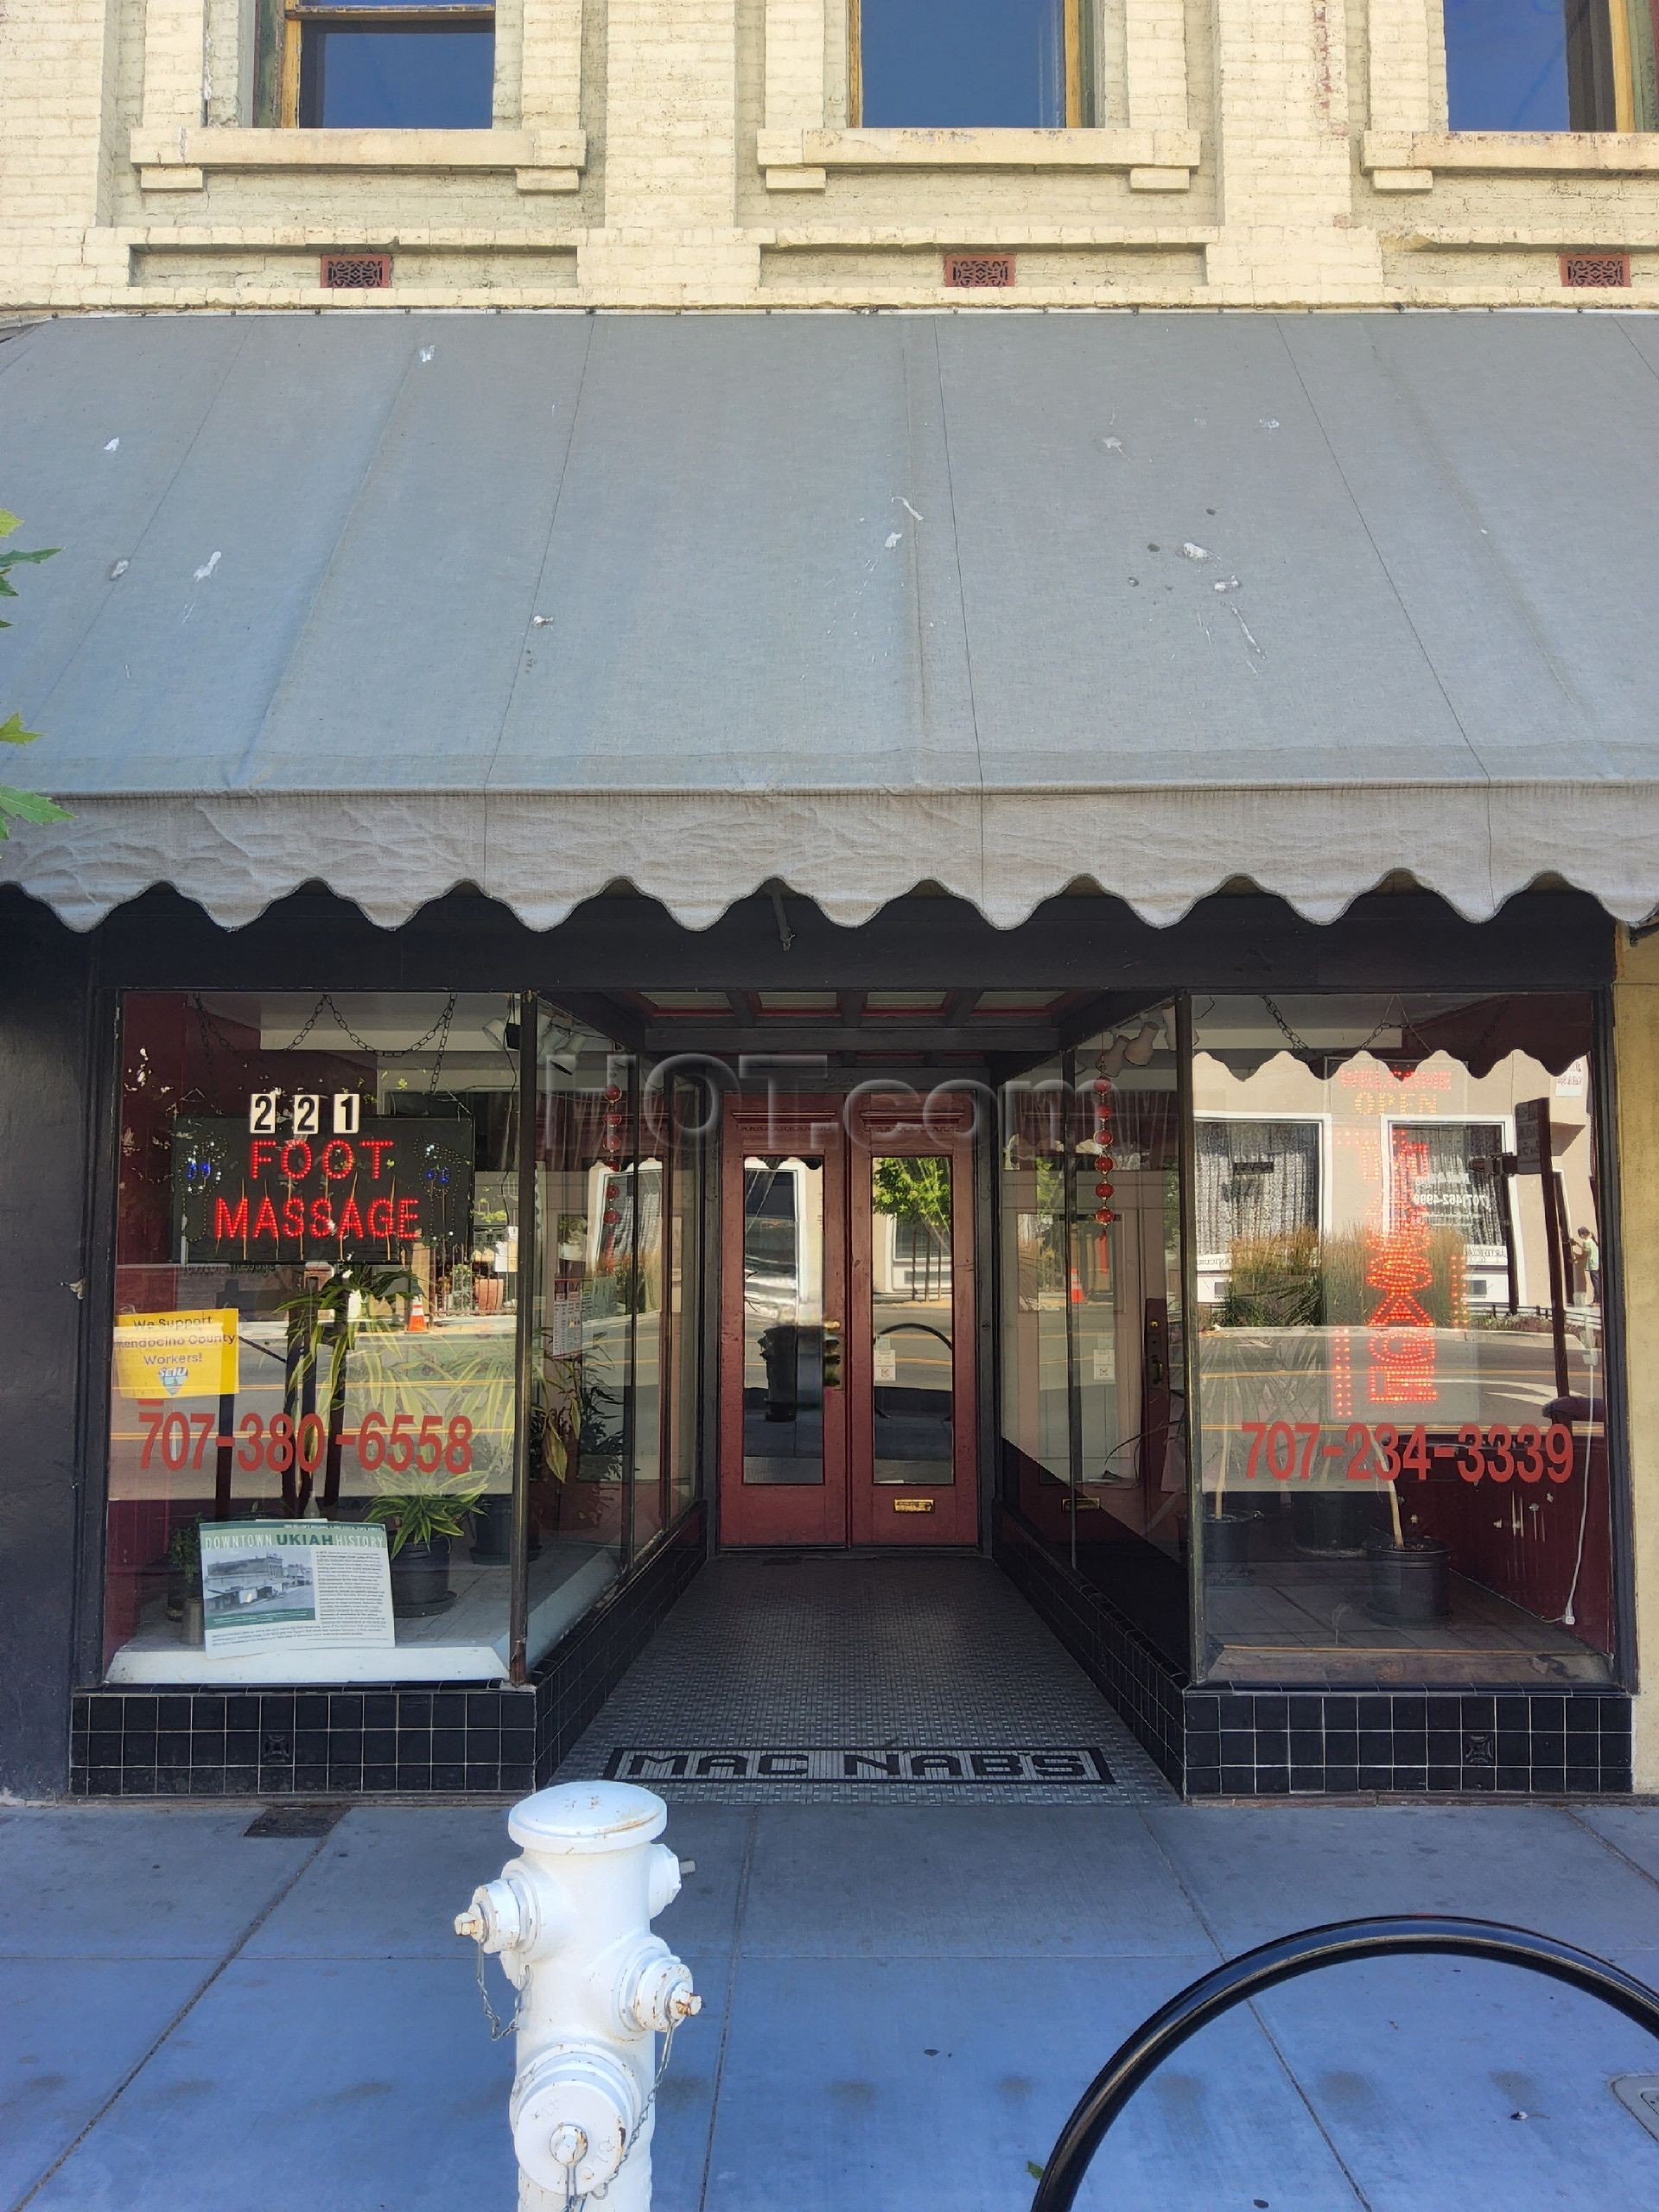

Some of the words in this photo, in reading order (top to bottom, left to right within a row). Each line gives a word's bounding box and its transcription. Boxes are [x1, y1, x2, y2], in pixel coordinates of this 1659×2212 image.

[252, 1095, 355, 1131] 221
[1354, 1091, 1438, 1117] OPEN
[250, 1139, 395, 1179] FOOT
[214, 1197, 419, 1240] MASSAGE
[133, 1319, 155, 1331] We
[158, 1316, 213, 1331] Support
[188, 1334, 236, 1347] County
[143, 1352, 202, 1366] Workers!
[159, 1367, 188, 1377] SEIU
[138, 1412, 474, 1473] 707-380-6558
[1241, 1421, 1575, 1484] 707-234-3339
[205, 1533, 272, 1549] DOWNTOWN
[276, 1534, 334, 1546] UKIAH
[336, 1535, 384, 1548] HISTORY
[628, 1753, 810, 1777] MAC
